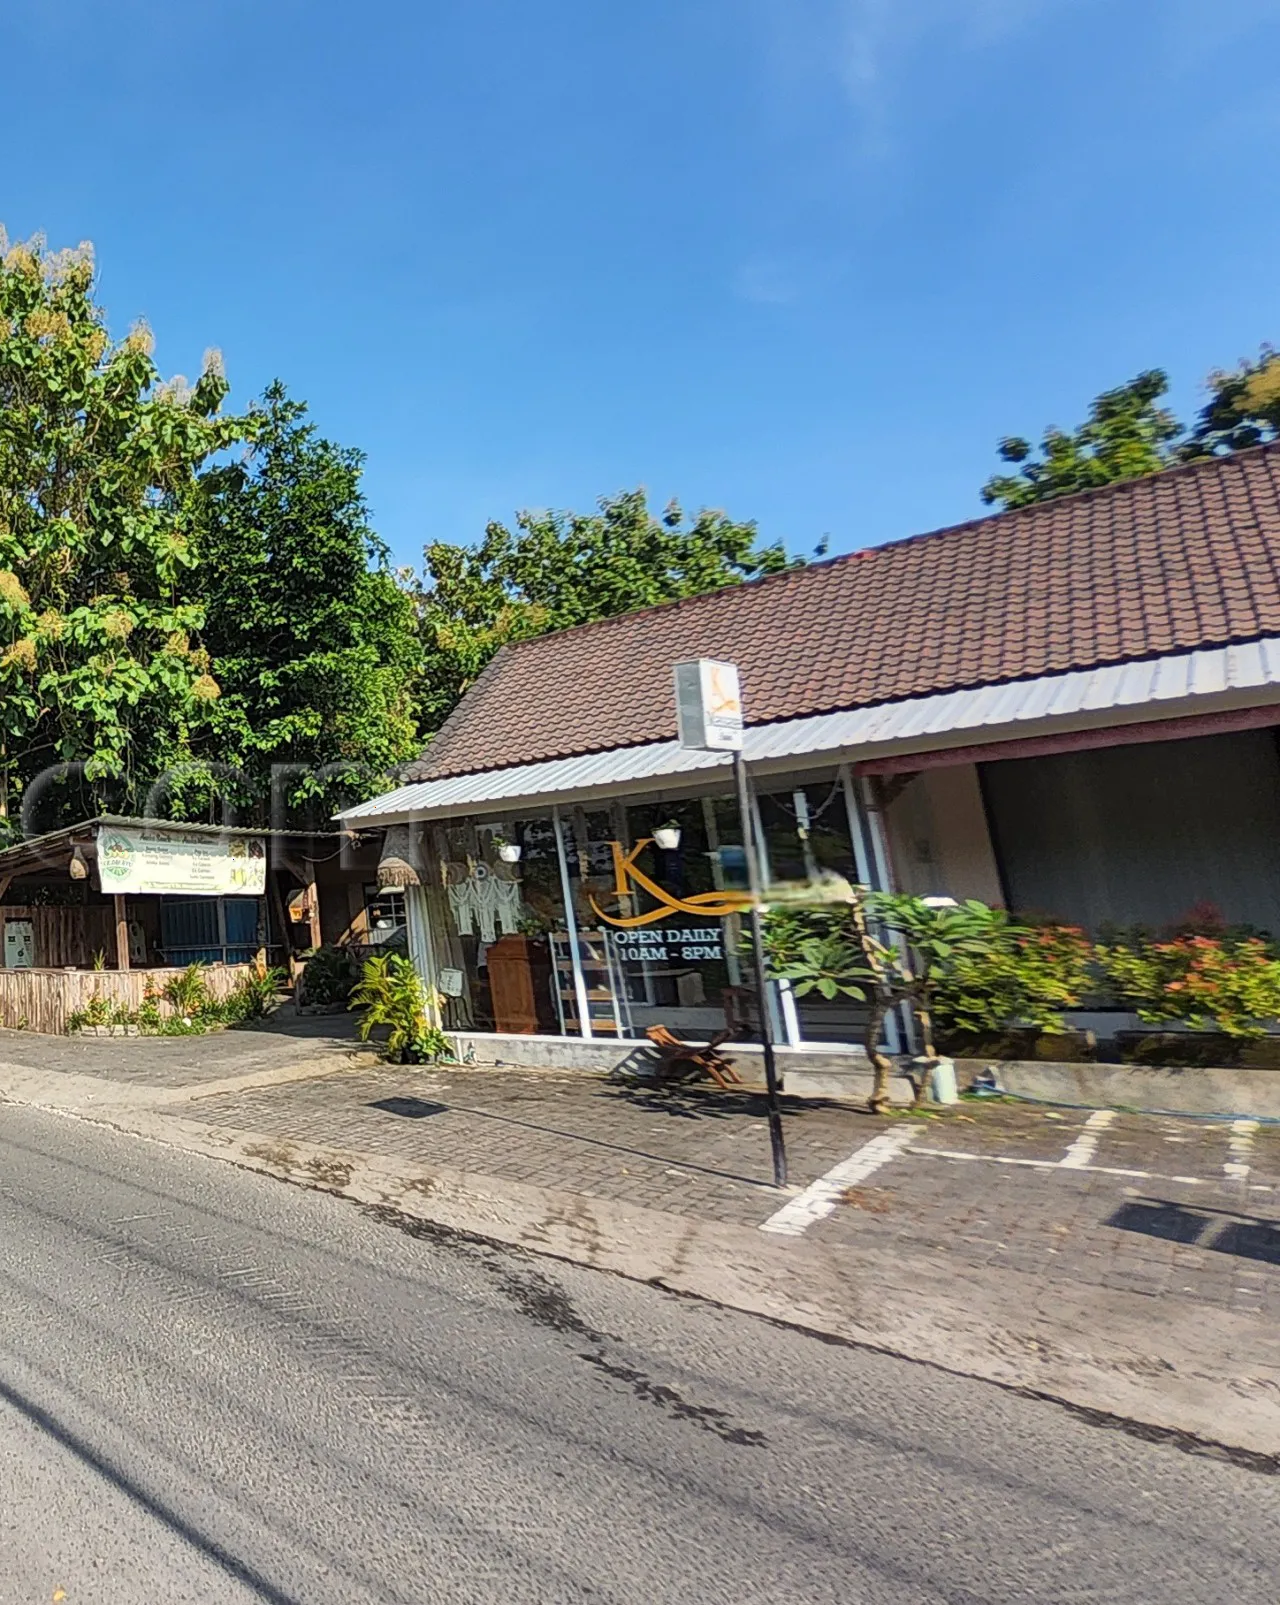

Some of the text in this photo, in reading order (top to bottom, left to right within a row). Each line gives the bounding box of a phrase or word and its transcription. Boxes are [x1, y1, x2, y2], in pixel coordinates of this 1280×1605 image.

[613, 928, 722, 944] OPEN DAILY
[620, 946, 669, 961] 10AM
[681, 946, 723, 960] 8PM
